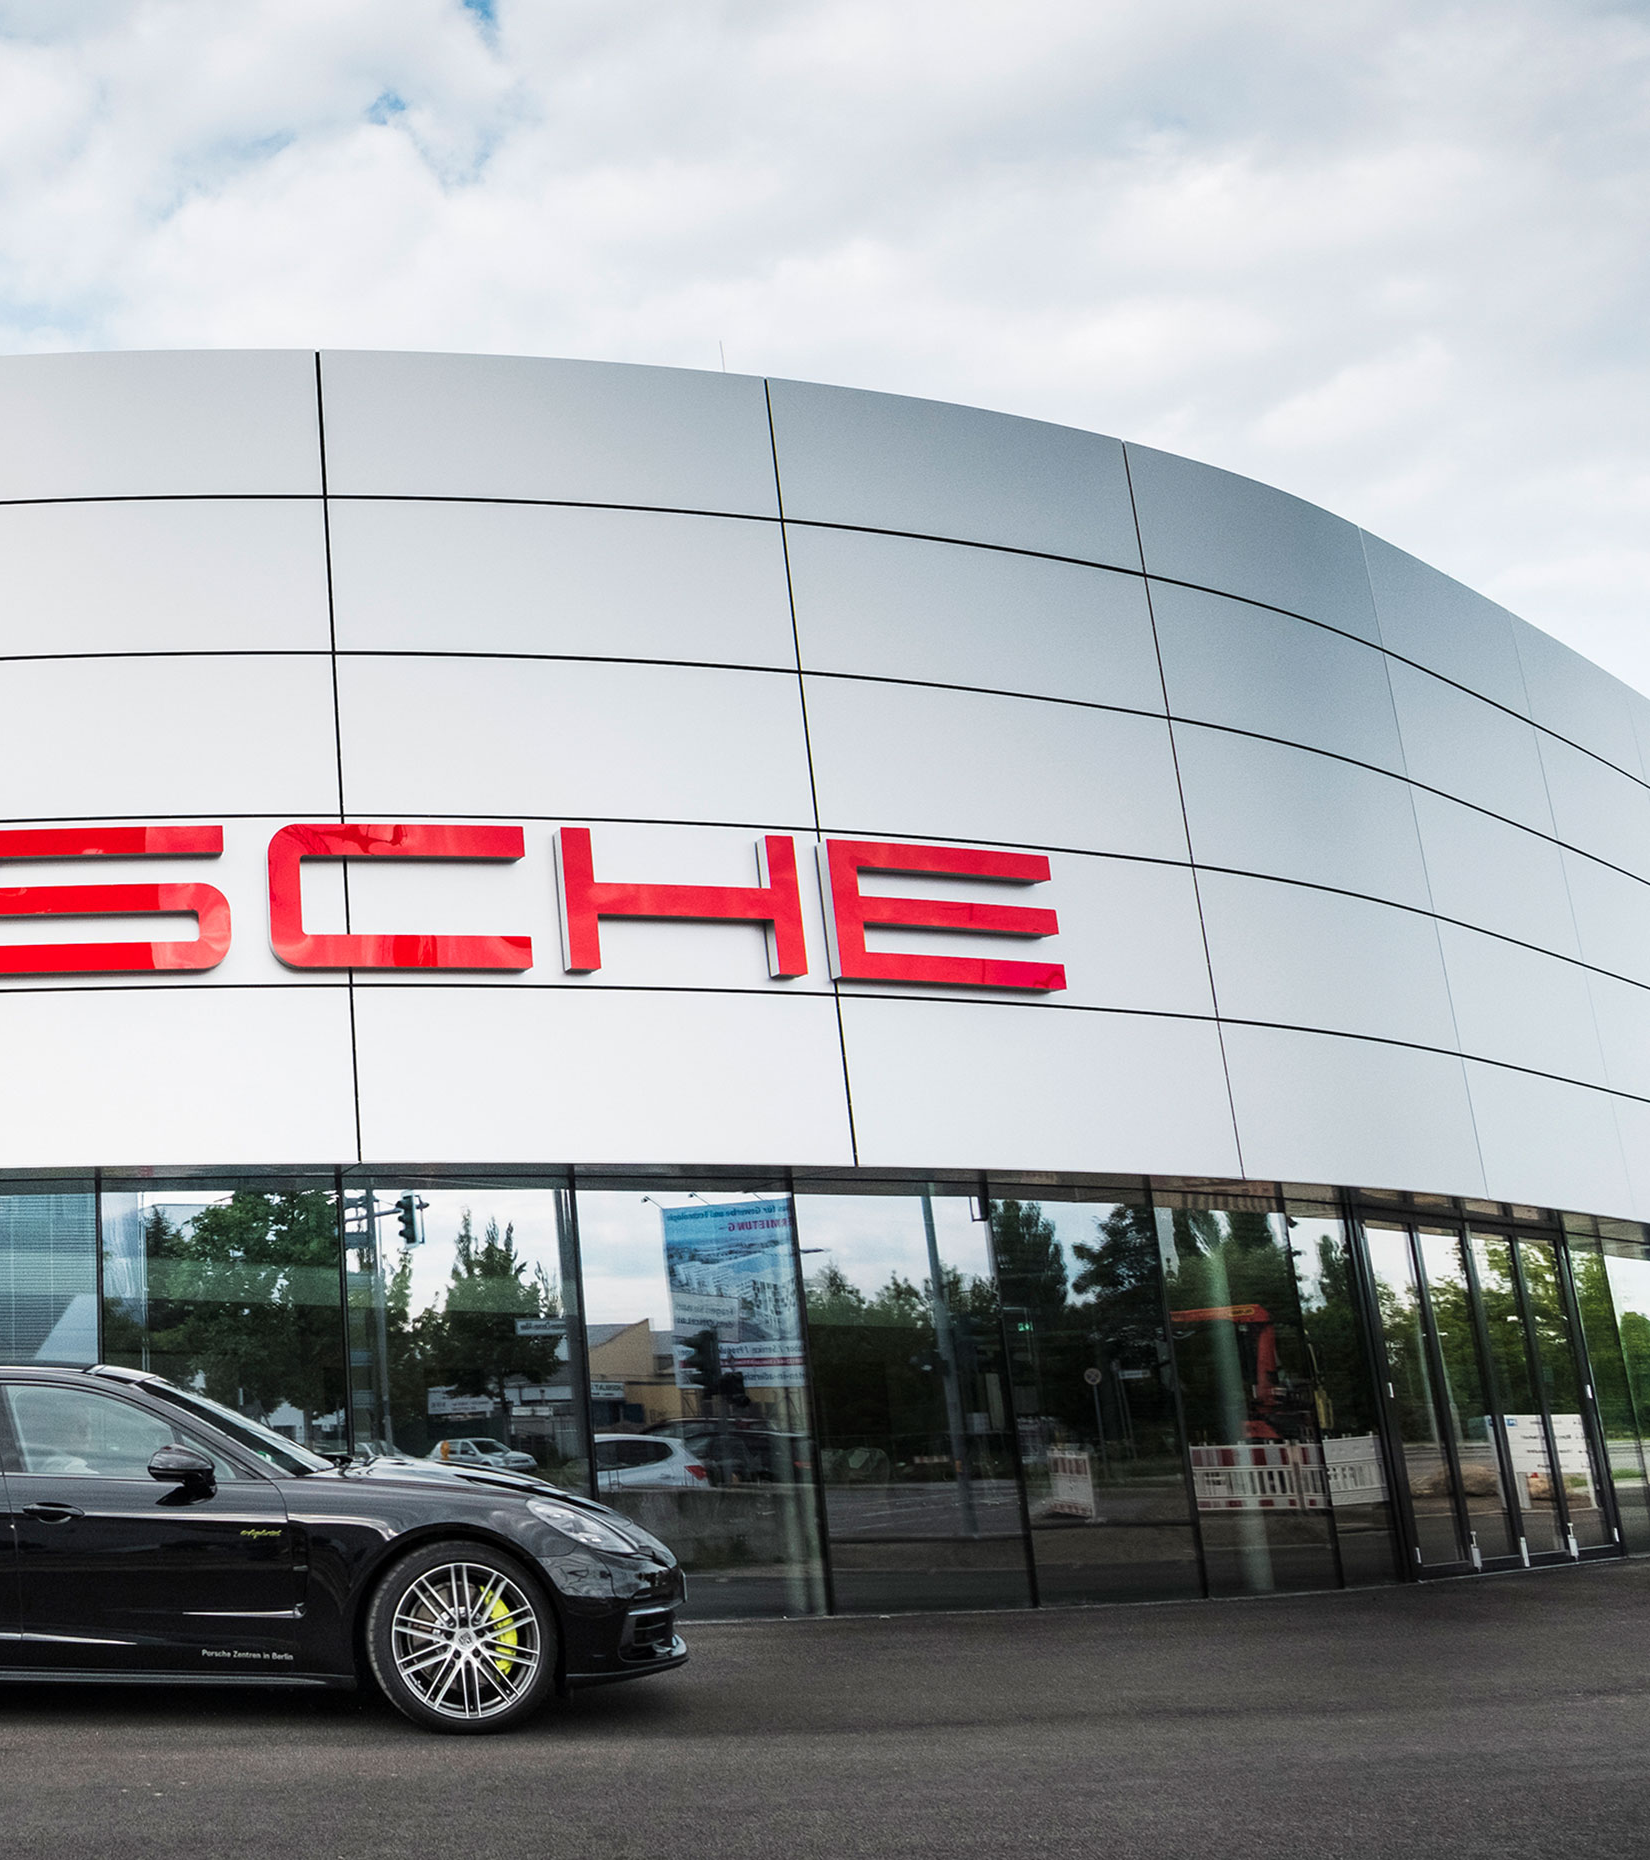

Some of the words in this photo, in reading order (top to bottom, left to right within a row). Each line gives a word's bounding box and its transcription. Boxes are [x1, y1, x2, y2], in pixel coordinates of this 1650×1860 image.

[201, 1648, 231, 1658] Porsche
[233, 1650, 261, 1659] Zentren
[262, 1651, 271, 1660] in
[271, 1651, 294, 1661] Berlin
